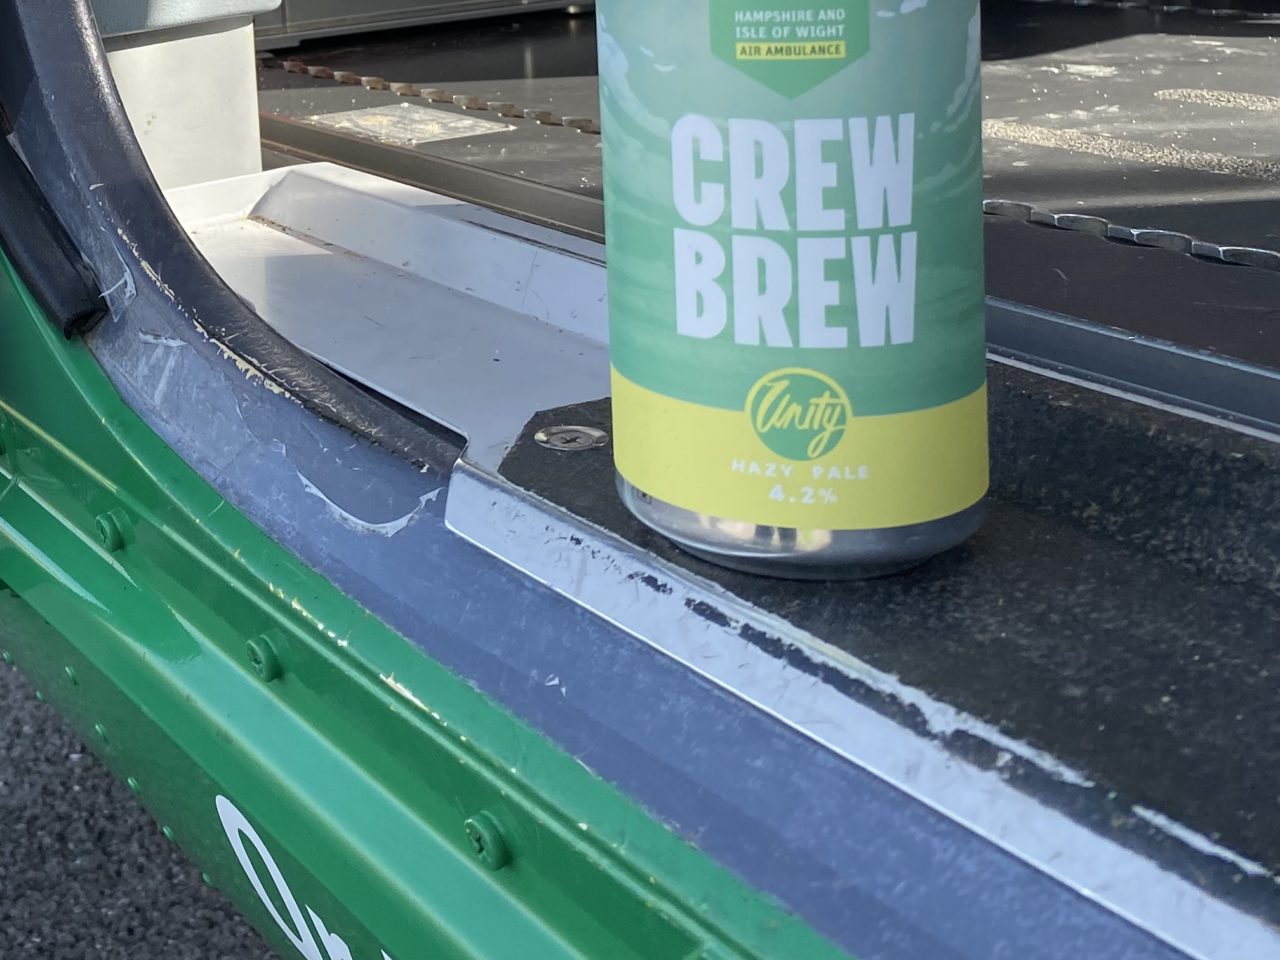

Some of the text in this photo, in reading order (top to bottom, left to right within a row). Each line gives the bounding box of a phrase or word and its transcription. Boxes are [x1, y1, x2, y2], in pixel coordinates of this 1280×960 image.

[735, 7, 846, 23] HAMPSHIRE AND
[735, 24, 845, 39] ISLE OF WIGHT
[740, 43, 842, 57] AIR AMBULANCE
[670, 112, 915, 232] CREW
[673, 227, 918, 349] BREW
[755, 378, 847, 459] Unity
[730, 457, 869, 480] HAZY PALE
[767, 483, 839, 505] 4.2%
